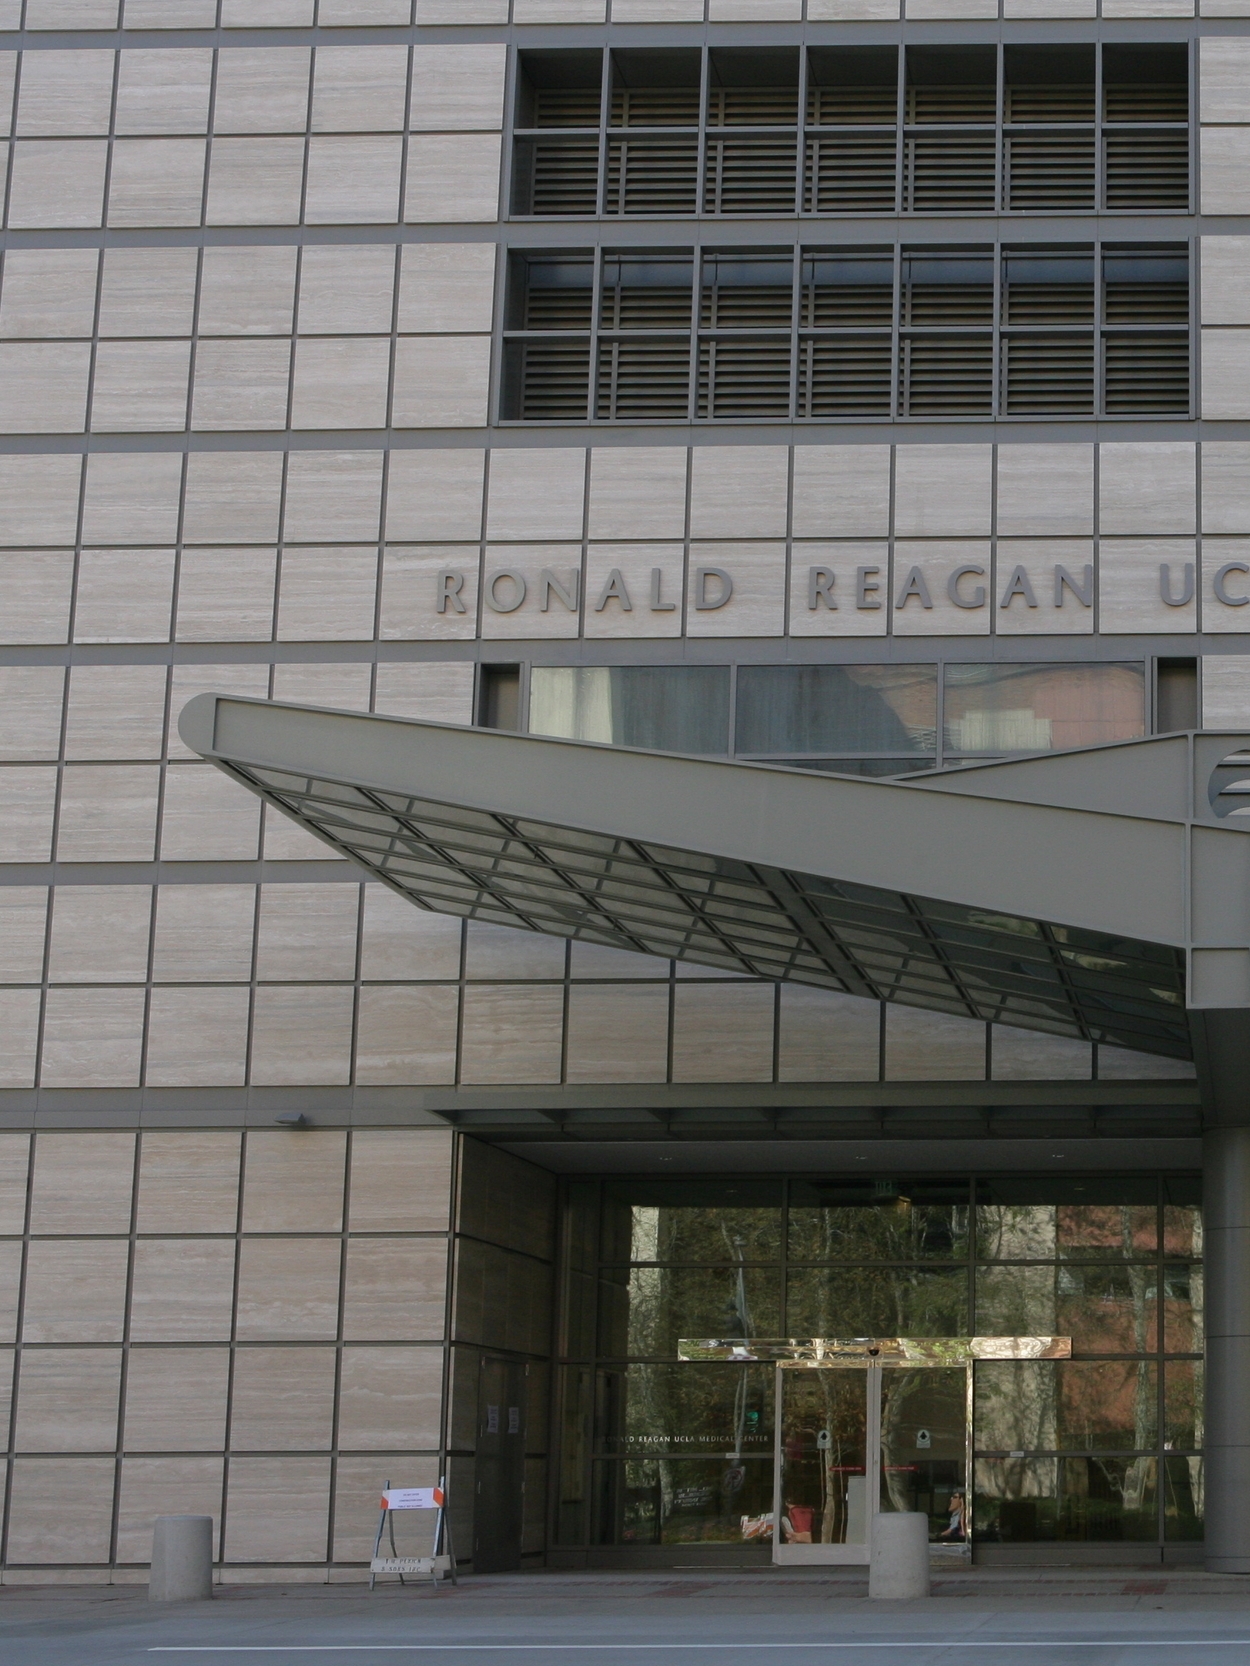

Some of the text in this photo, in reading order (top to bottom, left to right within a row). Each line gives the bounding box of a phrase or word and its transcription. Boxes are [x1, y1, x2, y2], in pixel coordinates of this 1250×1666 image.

[436, 567, 733, 614] RONALD
[807, 563, 1093, 611] REAGAN
[638, 1435, 671, 1443] REAGAN
[674, 1435, 695, 1443] UCLA
